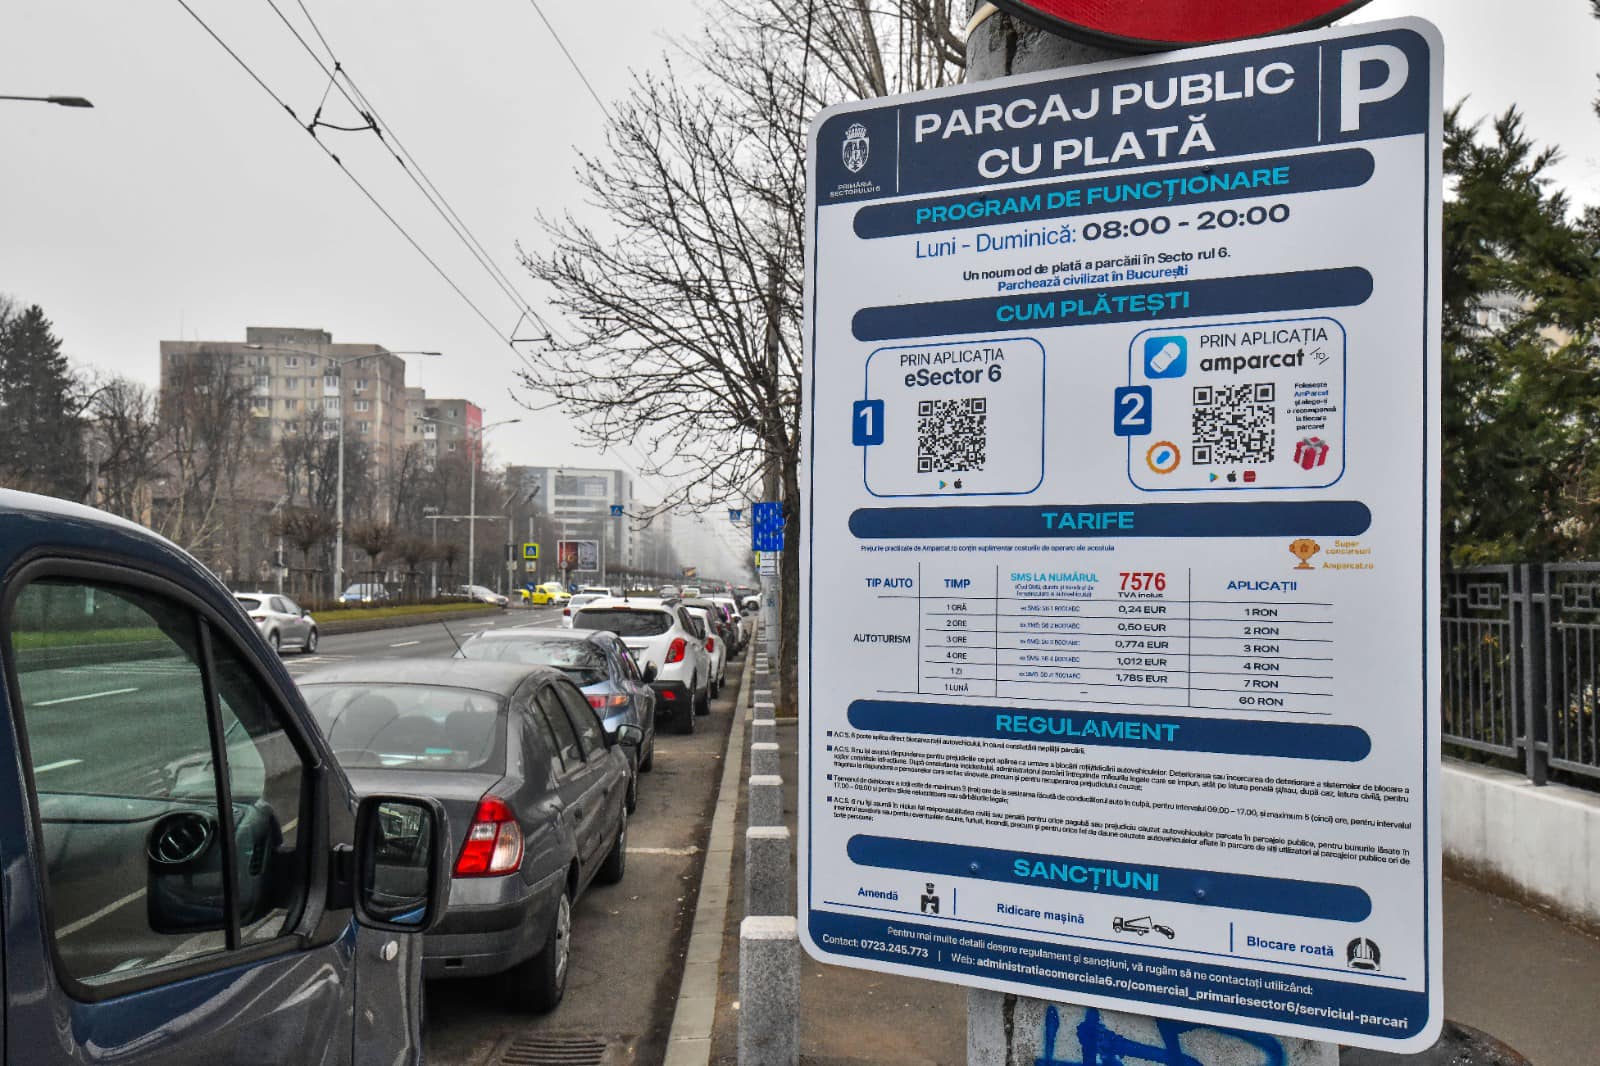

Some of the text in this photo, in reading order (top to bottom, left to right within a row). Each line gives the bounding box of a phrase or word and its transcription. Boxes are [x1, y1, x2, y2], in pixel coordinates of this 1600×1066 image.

[1339, 44, 1409, 132] P
[914, 61, 1295, 143] PARCAJ PUBLIC
[977, 112, 1216, 179] CU PLATĂ
[916, 166, 1290, 225] PROGRAM DE FUNCȚIONARE
[915, 236, 956, 259] Luni
[976, 223, 1076, 253] Duminică:
[1081, 215, 1171, 241] 08:00
[1196, 203, 1290, 231] 20:00
[962, 270, 980, 281] Un
[1033, 263, 1048, 275] de
[1051, 259, 1082, 275] plată
[1084, 261, 1093, 270] a
[1142, 253, 1155, 265] în
[1197, 247, 1215, 260] rul
[1217, 246, 1231, 258] 6.
[997, 275, 1061, 292] Parchează
[1062, 272, 1110, 286] civilizat
[1111, 270, 1124, 282] în
[995, 290, 1190, 322] CUM PLĂTEȘTI
[1200, 327, 1328, 348] PRIN APLICAȚIA
[900, 347, 1004, 367] PRIN APLICAȚIA
[1199, 347, 1305, 375] amparcat
[904, 363, 1002, 388] eSector 6
[1120, 392, 1145, 425] 2
[859, 406, 873, 436] 1
[1040, 510, 1135, 529] TARIFE
[865, 577, 913, 588] TIP AUTO
[943, 578, 971, 589] TIMP
[1010, 570, 1099, 583] SMS LA NUMĂRUL
[1119, 571, 1166, 591] 7576
[1226, 580, 1297, 593] APLICAȚII
[1118, 605, 1166, 614] 0,24 EUR
[1244, 607, 1278, 617] 1 RON
[853, 633, 911, 644] AUTOTURISM
[1243, 626, 1279, 635] 2 RON
[1114, 639, 1169, 649] 0,774 EUR
[1243, 644, 1279, 653] 3 RON
[1116, 657, 1167, 666] 1,012 EUR
[1242, 662, 1279, 671] 4 RON
[1115, 673, 1168, 683] 1,785 EUR
[1243, 679, 1279, 689] 7 RON
[1238, 696, 1284, 706] 60 RON
[995, 714, 1180, 742] REGULAMENT
[1013, 858, 1159, 892] SANCȚIUNI
[857, 886, 898, 901] Amendă
[996, 903, 1084, 925] Ridicare mașină
[822, 933, 859, 948] Contact:
[860, 938, 929, 958] 0723.245.773
[950, 952, 975, 965] Web:
[1246, 935, 1334, 957] Blocare roată
[887, 925, 1313, 995] Pentru mai multe detalii despre regulament și sancțiuni, vă rugăm să ne contactați utilizând:
